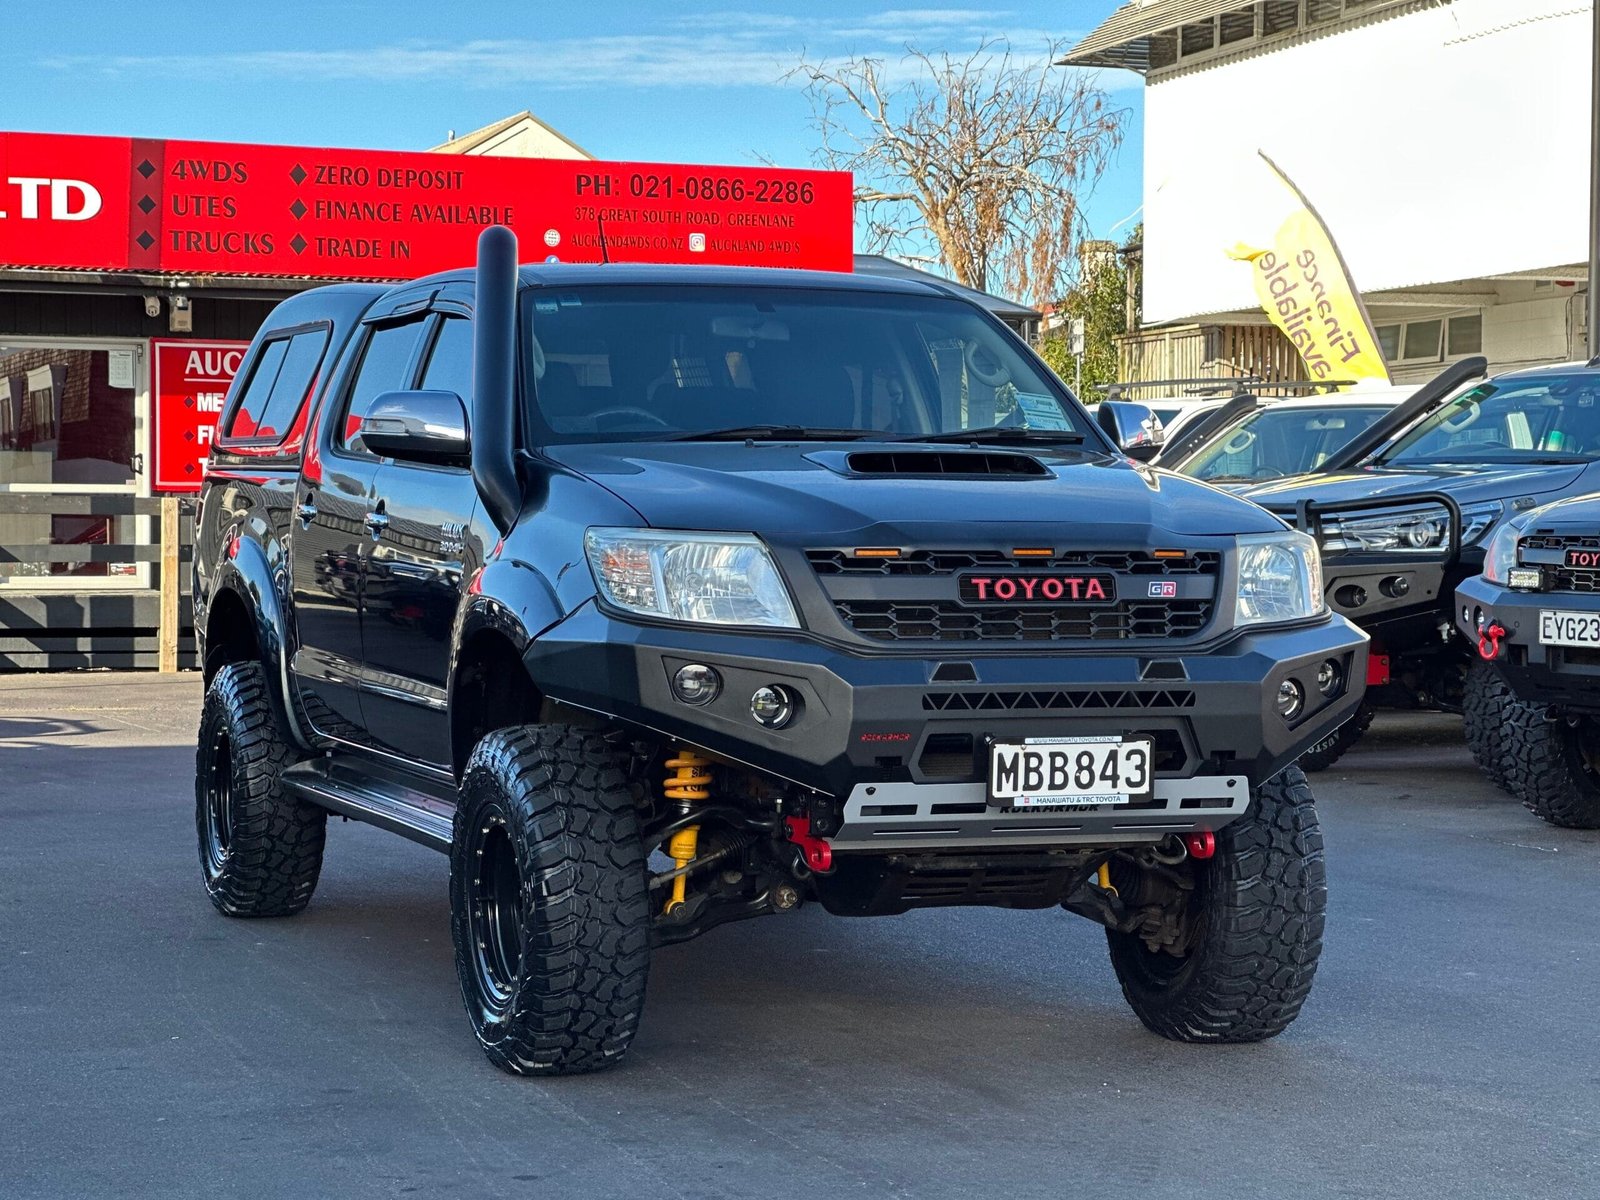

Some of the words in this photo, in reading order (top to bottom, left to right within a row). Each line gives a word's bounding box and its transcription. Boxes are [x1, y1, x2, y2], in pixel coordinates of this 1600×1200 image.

[171, 159, 248, 184] 4WDS
[314, 166, 369, 187] ZERO
[377, 168, 464, 190] DEPOSIT
[0, 176, 103, 221] TD
[576, 174, 620, 196] PH:
[630, 174, 814, 205] 021-0866-2286
[172, 194, 237, 218] UTES
[315, 200, 402, 222] FINANCE
[410, 203, 514, 226] AVAILABLE
[575, 207, 595, 221] 378
[600, 208, 638, 223] GREAT
[642, 209, 682, 224] SOUTH
[728, 212, 795, 228] GREENLANE
[168, 230, 274, 254] TRUCKS
[314, 237, 382, 258] TRADE
[390, 240, 410, 259] IN
[710, 239, 765, 253] AUCKLAND
[1570, 552, 1600, 566] TOY
[970, 577, 1106, 600] TOYOTA
[1151, 585, 1173, 594] GR
[1543, 616, 1600, 641] EYG23
[996, 748, 1147, 793] MBB843
[1096, 794, 1121, 803] TOYOTA
